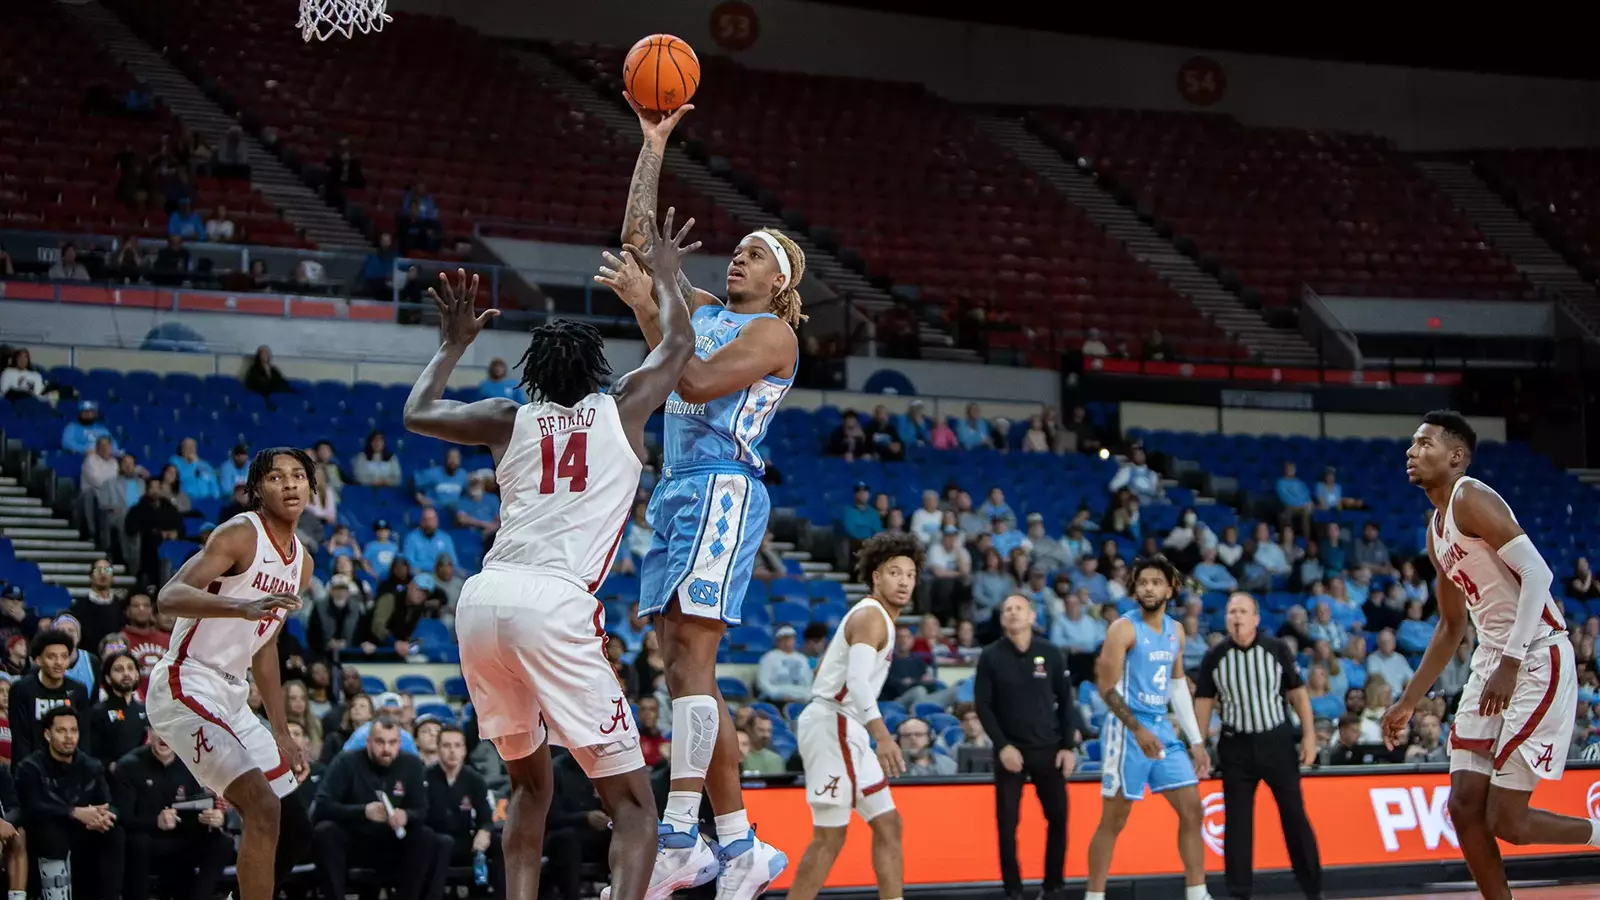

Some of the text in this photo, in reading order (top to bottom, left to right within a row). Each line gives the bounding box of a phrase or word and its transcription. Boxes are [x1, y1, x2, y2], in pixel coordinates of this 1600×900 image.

[720, 14, 750, 38] 53
[1184, 70, 1216, 94] 54
[695, 335, 715, 354] RTH
[664, 399, 706, 415] AROLINA
[537, 408, 596, 437] BEDKO
[540, 432, 588, 494] 14
[1153, 665, 1167, 690] 4
[1368, 785, 1460, 852] PK
